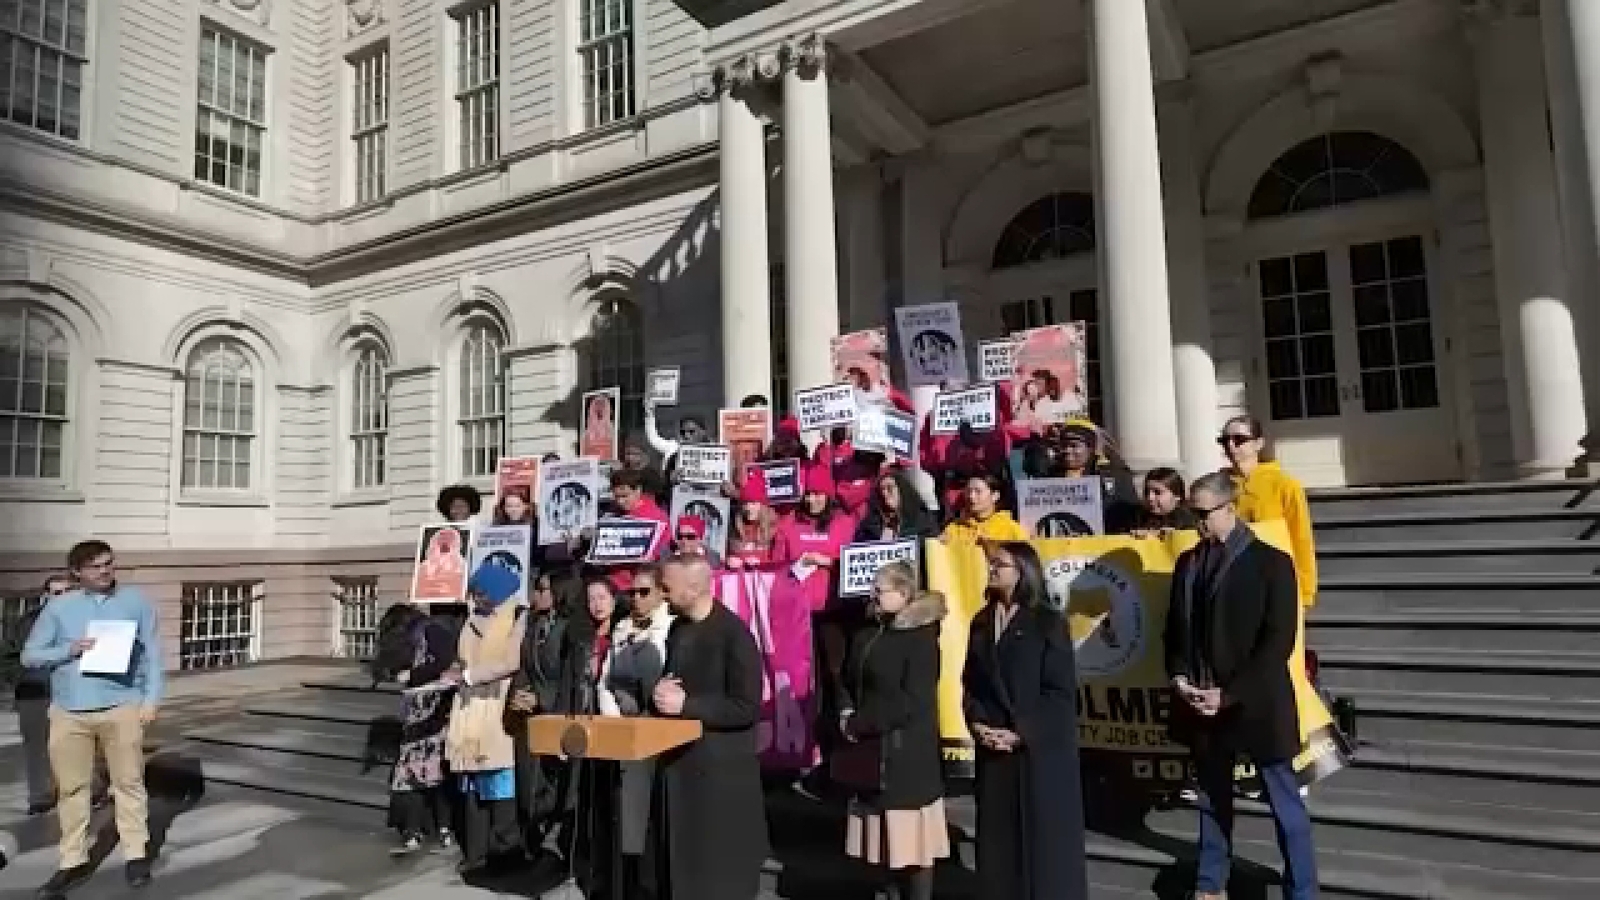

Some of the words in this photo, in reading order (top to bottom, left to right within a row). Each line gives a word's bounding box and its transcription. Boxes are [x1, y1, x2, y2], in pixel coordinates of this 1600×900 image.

[800, 388, 851, 406] PROTECT
[939, 392, 991, 408] PROTECT
[801, 404, 823, 416] NYC
[804, 409, 854, 425] FAMILIES
[939, 407, 966, 418] NYC
[682, 449, 728, 462] PROTECT
[849, 546, 912, 563] PROTECT
[1049, 561, 1127, 593] COLMENA
[1104, 726, 1141, 746] JOB
